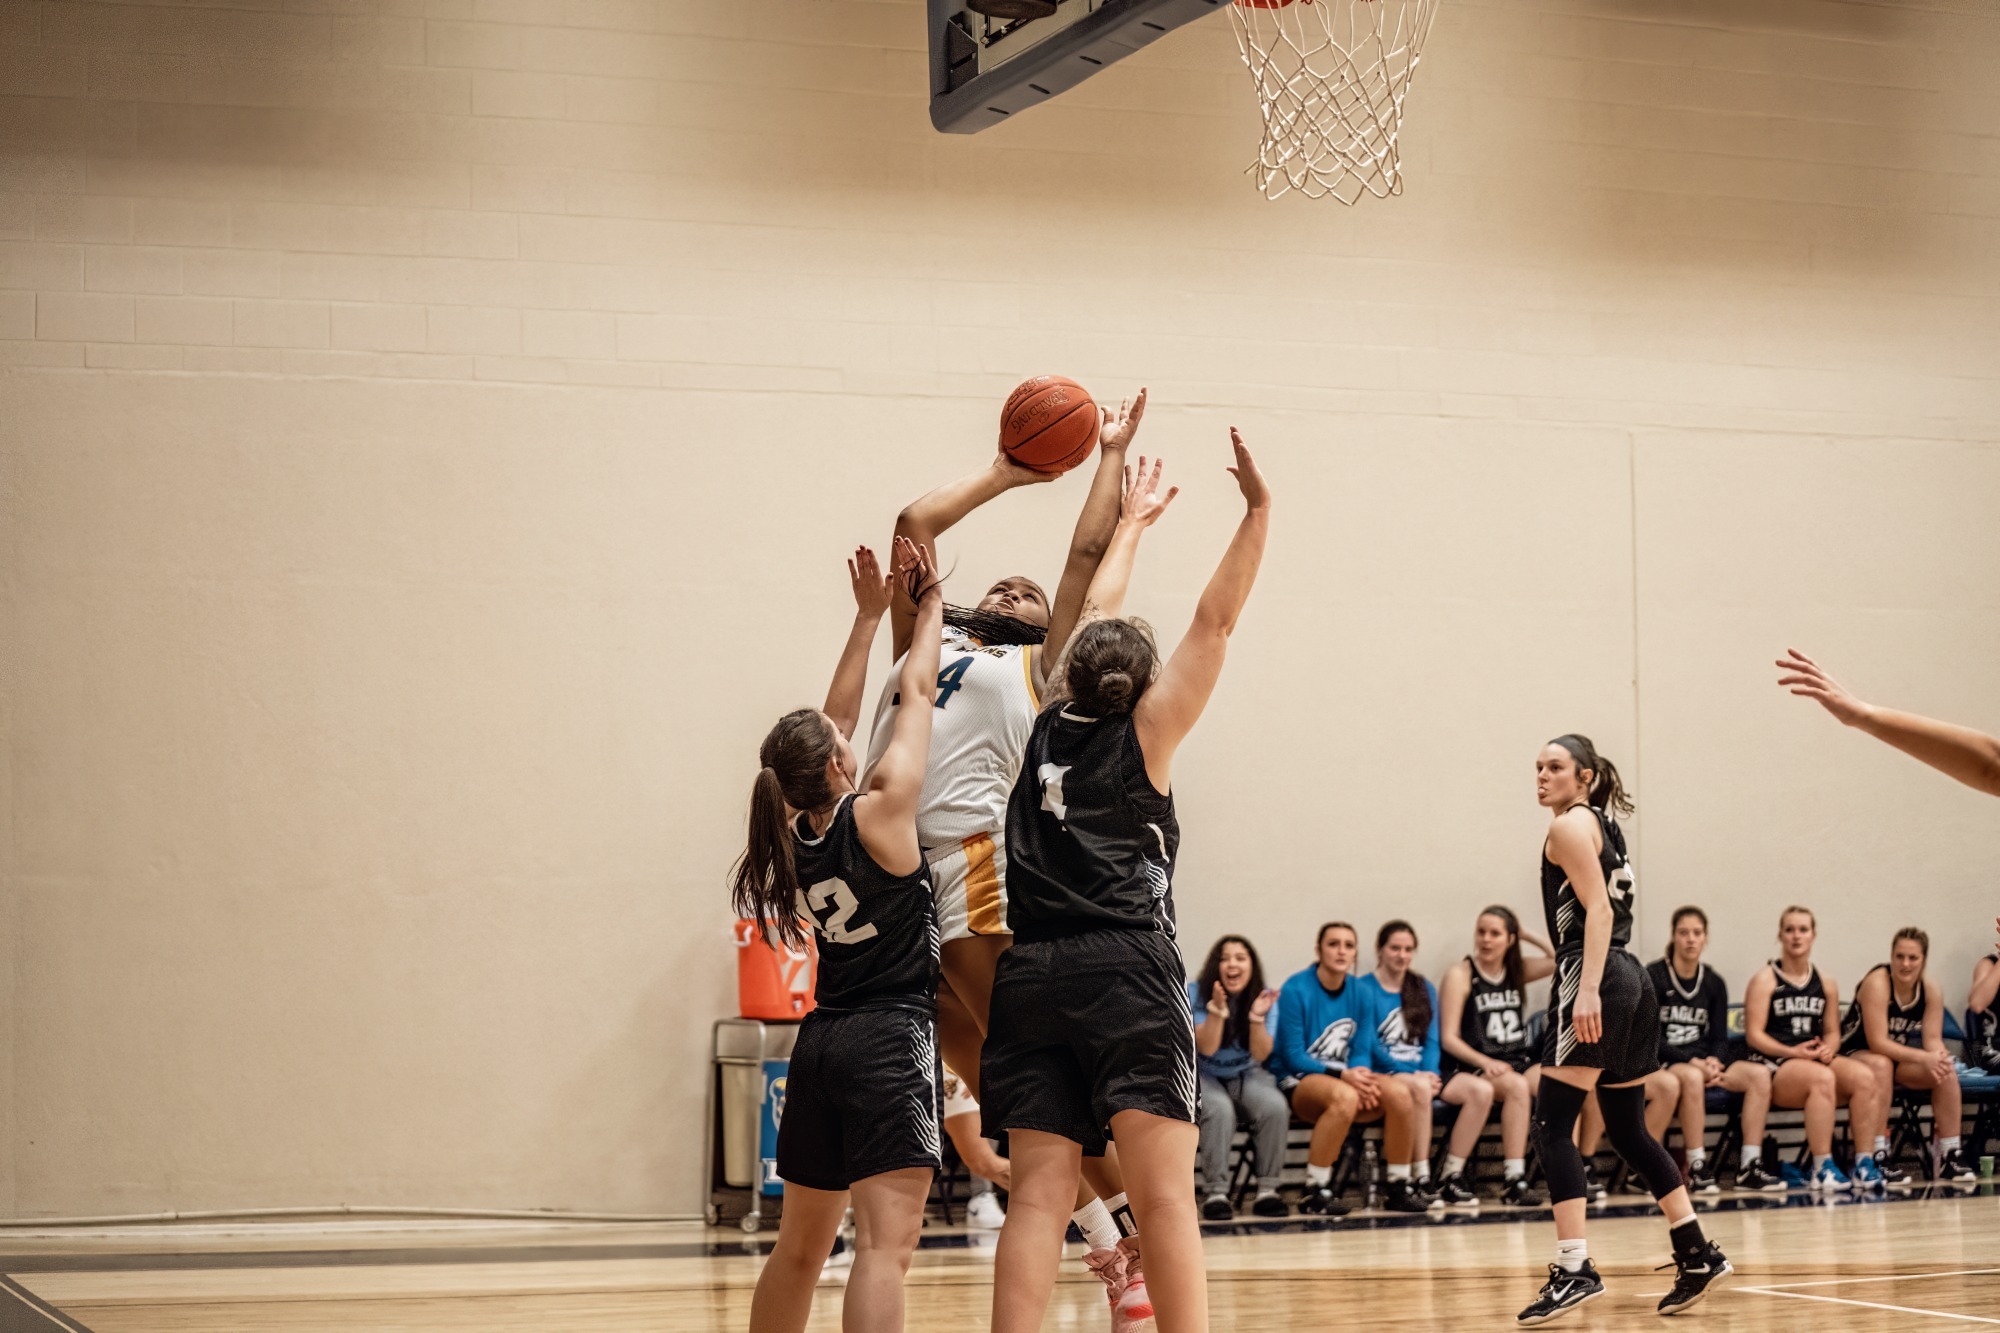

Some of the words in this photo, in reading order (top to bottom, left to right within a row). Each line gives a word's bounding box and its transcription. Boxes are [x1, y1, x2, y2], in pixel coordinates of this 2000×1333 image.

[1011, 388, 1070, 435] SPALDING
[1773, 996, 1825, 1016] EAGLES
[1486, 1010, 1523, 1044] 42
